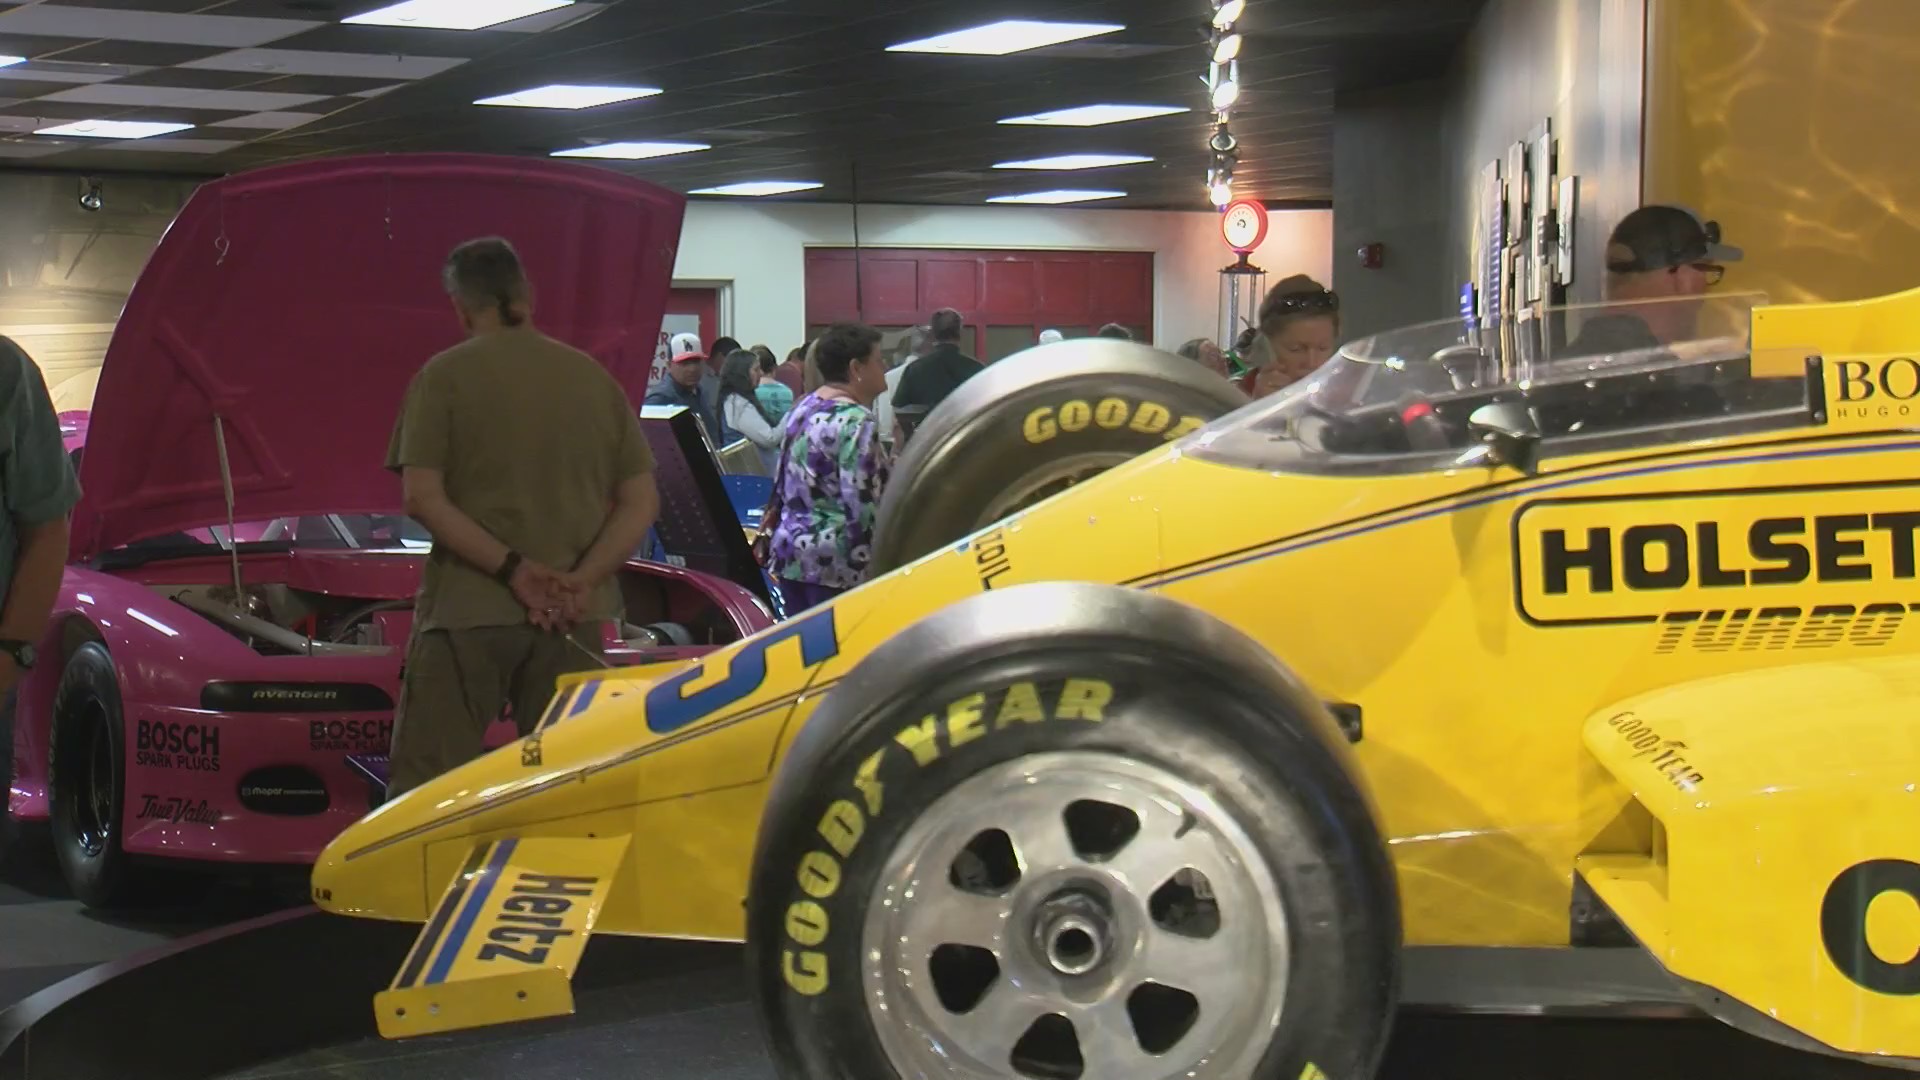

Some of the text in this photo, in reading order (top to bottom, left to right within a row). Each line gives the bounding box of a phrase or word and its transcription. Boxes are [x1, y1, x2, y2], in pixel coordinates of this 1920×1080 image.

[1833, 357, 1920, 402] BO
[1837, 404, 1911, 419] HUGO
[1540, 511, 1920, 596] HOLSET
[1653, 602, 1906, 655] TURBO
[252, 689, 337, 699] AVENGER
[137, 719, 220, 755] BOSCH
[310, 720, 394, 740] BOSCH
[136, 750, 221, 772] SPARK PLUGS
[476, 872, 599, 965] Hertz
